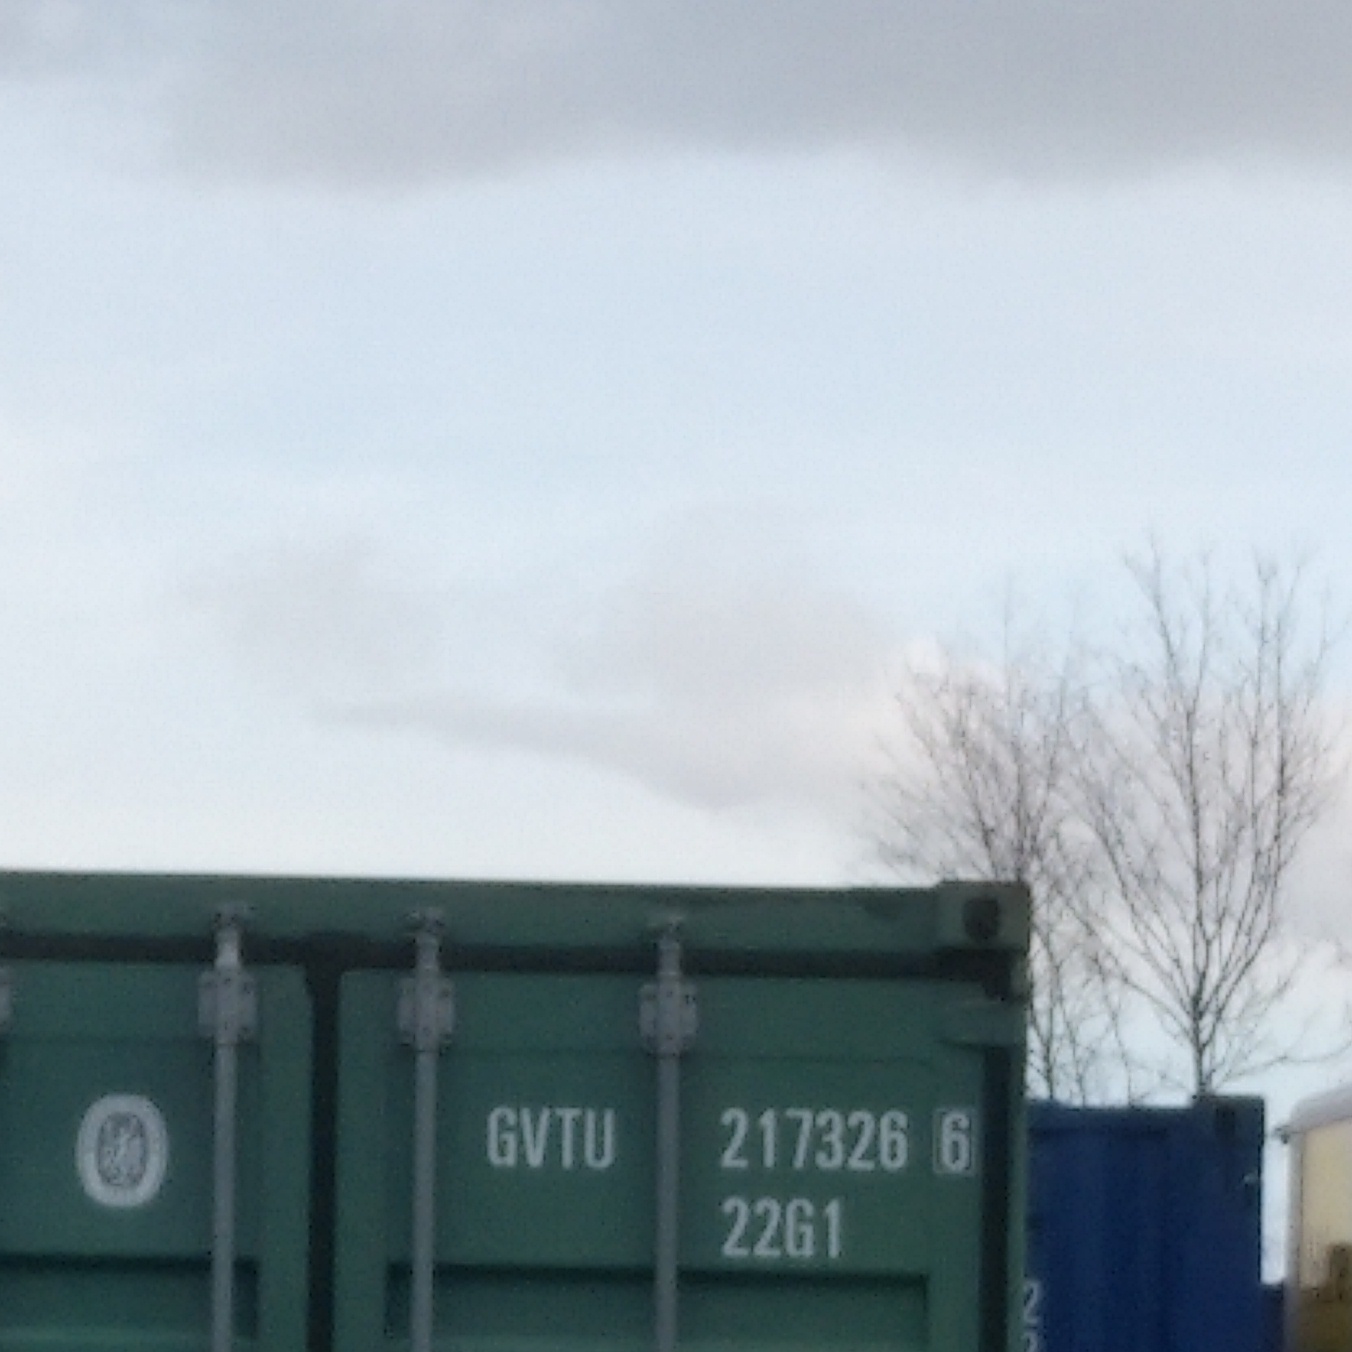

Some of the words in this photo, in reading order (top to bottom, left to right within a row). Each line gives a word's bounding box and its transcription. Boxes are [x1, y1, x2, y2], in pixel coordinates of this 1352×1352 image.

[486, 1106, 615, 1170] GVTU
[720, 1107, 909, 1172] 217326
[939, 1110, 972, 1174] 6
[720, 1197, 844, 1259] 22G1
